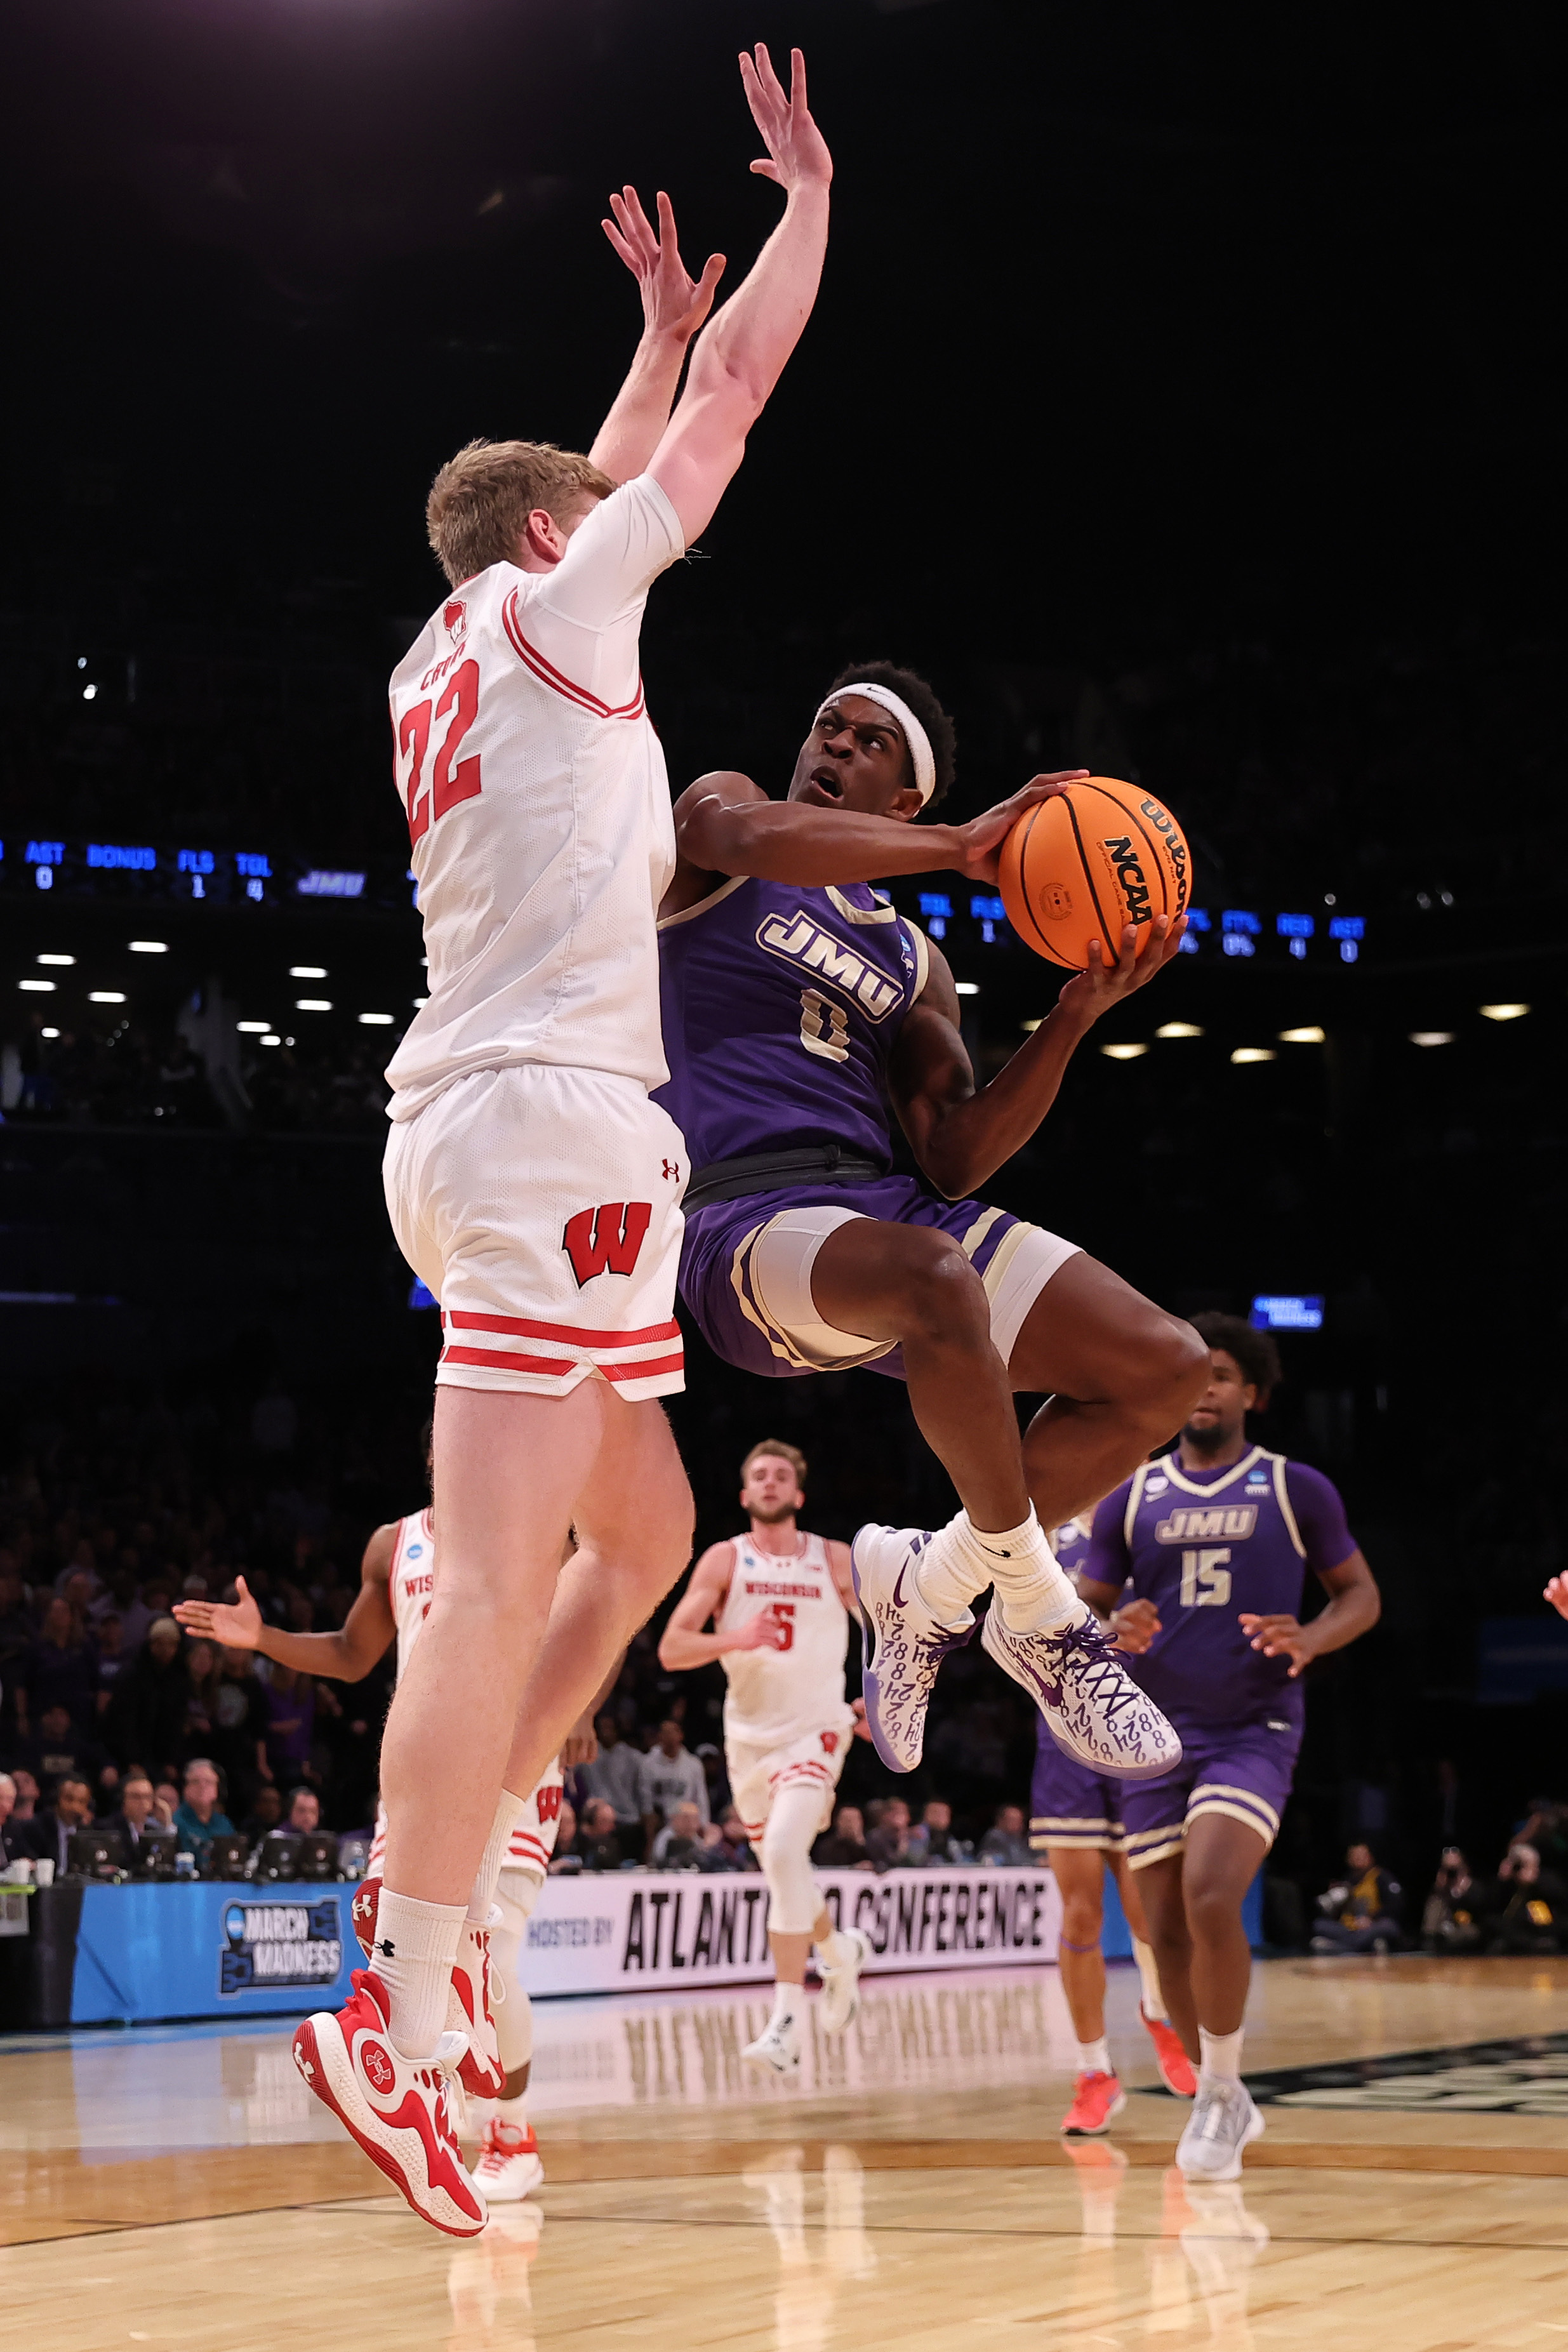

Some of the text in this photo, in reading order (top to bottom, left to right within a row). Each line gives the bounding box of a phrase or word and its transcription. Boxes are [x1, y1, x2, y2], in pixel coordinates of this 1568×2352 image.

[399, 658, 482, 849] 22
[86, 843, 157, 870] BONUS
[36, 865, 53, 889] 0
[192, 874, 206, 898] 1
[1104, 835, 1153, 926] NCAA
[762, 919, 900, 1018] JMU
[799, 988, 851, 1063] 0
[562, 1201, 653, 1289] W
[1159, 1507, 1254, 1540] JMU
[404, 1574, 434, 1597] WIS
[745, 1581, 821, 1599] WISCONSIN
[1179, 1546, 1232, 1607] 15
[773, 1604, 795, 1651] 5
[537, 1786, 564, 1825] W
[244, 1907, 309, 1943] MARCH
[622, 1889, 770, 1970] ATLANTI
[857, 1883, 1045, 1954] CONFERENCE
[254, 1939, 341, 1977] MADNESS
